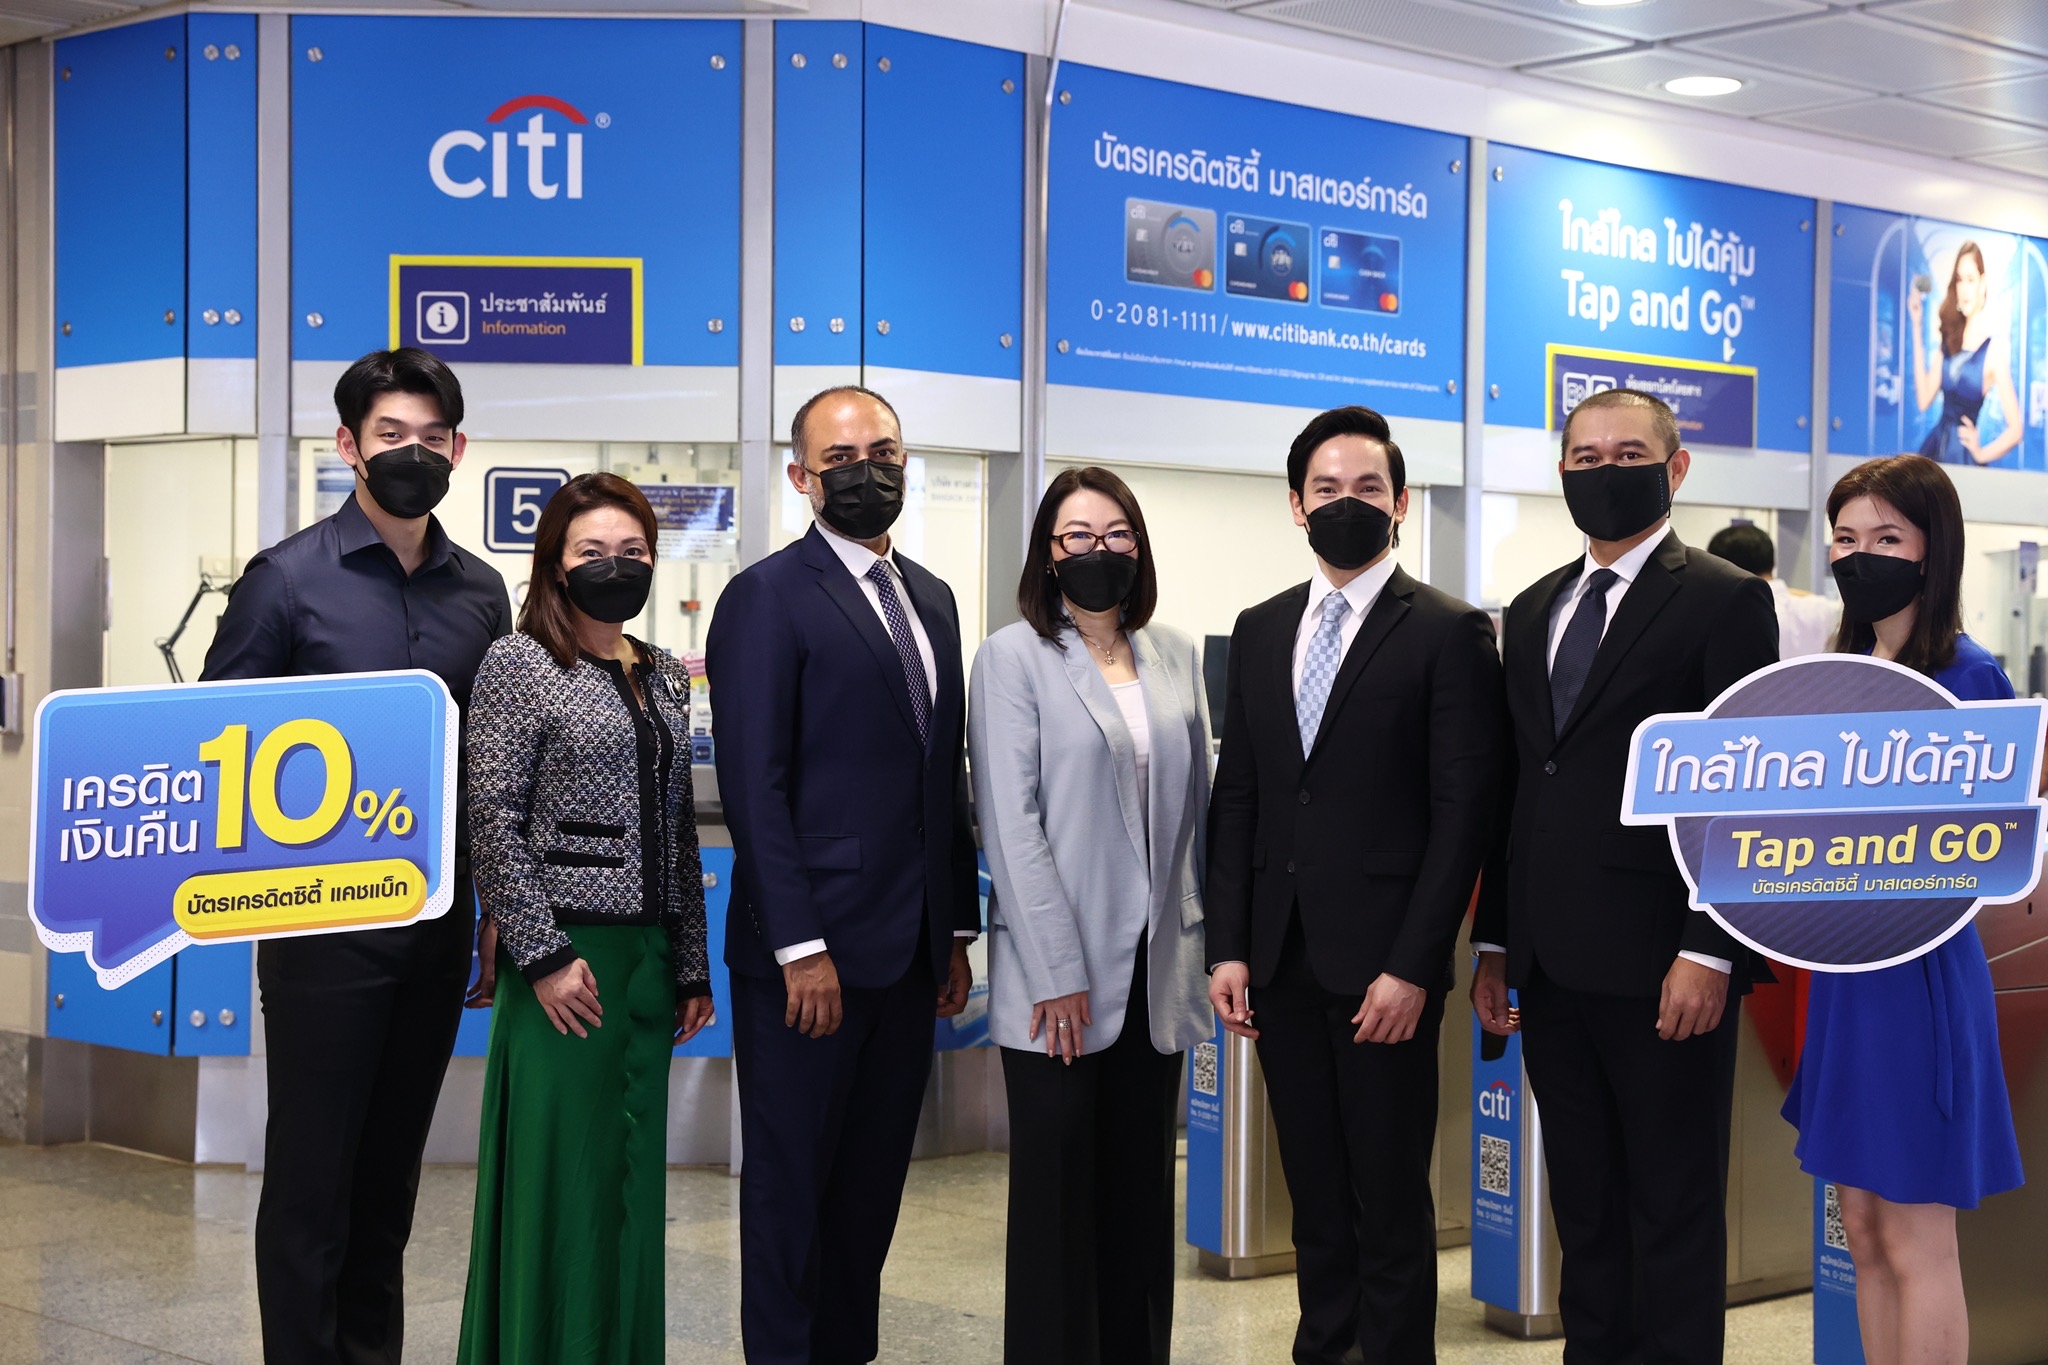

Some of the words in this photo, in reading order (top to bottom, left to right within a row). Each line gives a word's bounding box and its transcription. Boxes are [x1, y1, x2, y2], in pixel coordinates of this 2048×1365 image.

[428, 113, 583, 199] citi
[1094, 131, 1261, 193] บัตรเครดิตซิตี้
[1270, 168, 1428, 218] มาสเตอร์การ์ด
[1559, 199, 1656, 263] ใกล้ไกล
[1664, 217, 1755, 286] ไปได้คุ้ม
[480, 291, 608, 314] ประชาสัมพันธ์
[1561, 269, 1620, 331] Tap
[1629, 286, 1689, 331] and
[482, 320, 566, 335] Information
[511, 487, 543, 535] 5
[62, 763, 201, 810] เครดิต
[198, 718, 413, 848] 10%
[1652, 735, 1825, 792] ใกล้ไกล
[1839, 728, 2016, 795] ไปได้คุ้ม
[59, 810, 198, 861] เงินคืน
[1731, 831, 1814, 875] Tap
[1825, 824, 1918, 865] and
[187, 878, 324, 915] บัตรเครดิตซิตี้
[330, 875, 408, 902] แคชแบ็ก
[1752, 873, 1859, 894] บัตรเครดิตซิตี้
[1865, 874, 1977, 891] มาสเตอร์การ์ด
[1479, 1088, 1510, 1121] citi
